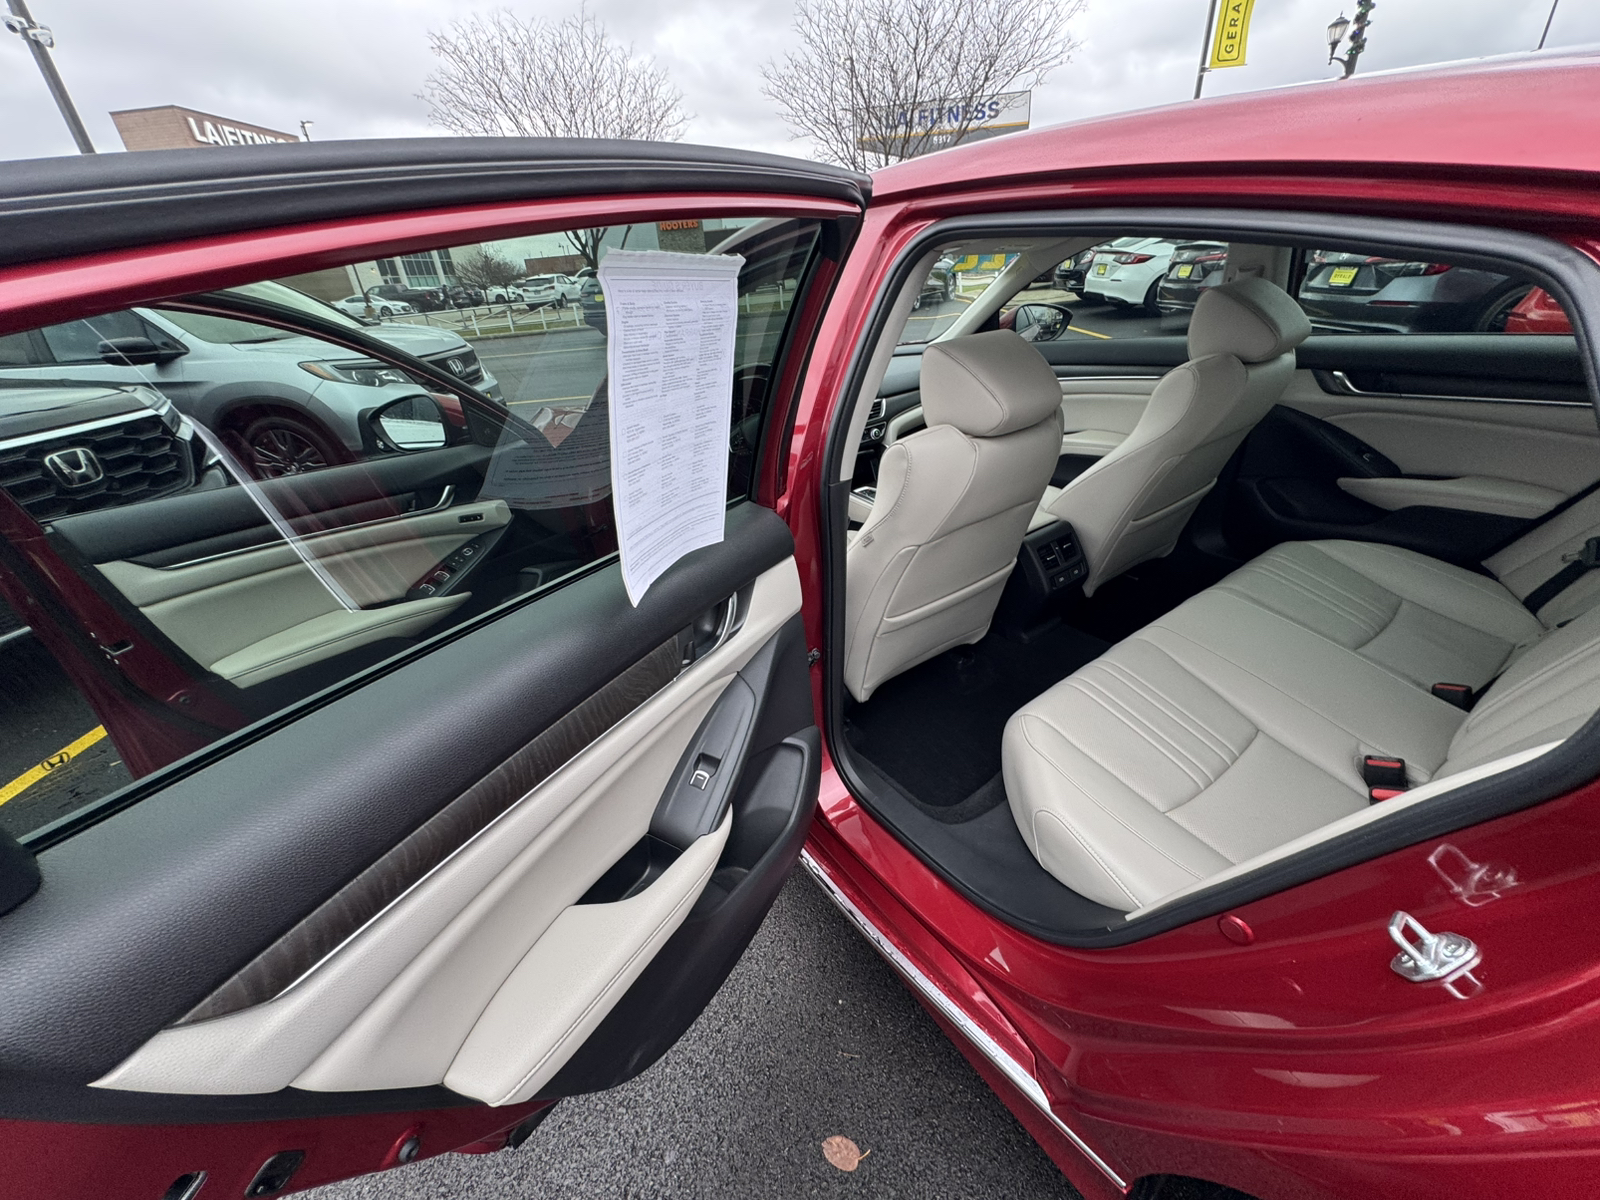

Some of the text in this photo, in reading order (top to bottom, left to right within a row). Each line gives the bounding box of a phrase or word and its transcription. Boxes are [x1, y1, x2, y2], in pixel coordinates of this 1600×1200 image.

[187, 117, 294, 146] LA FITN
[660, 219, 698, 231] HOOTERS
